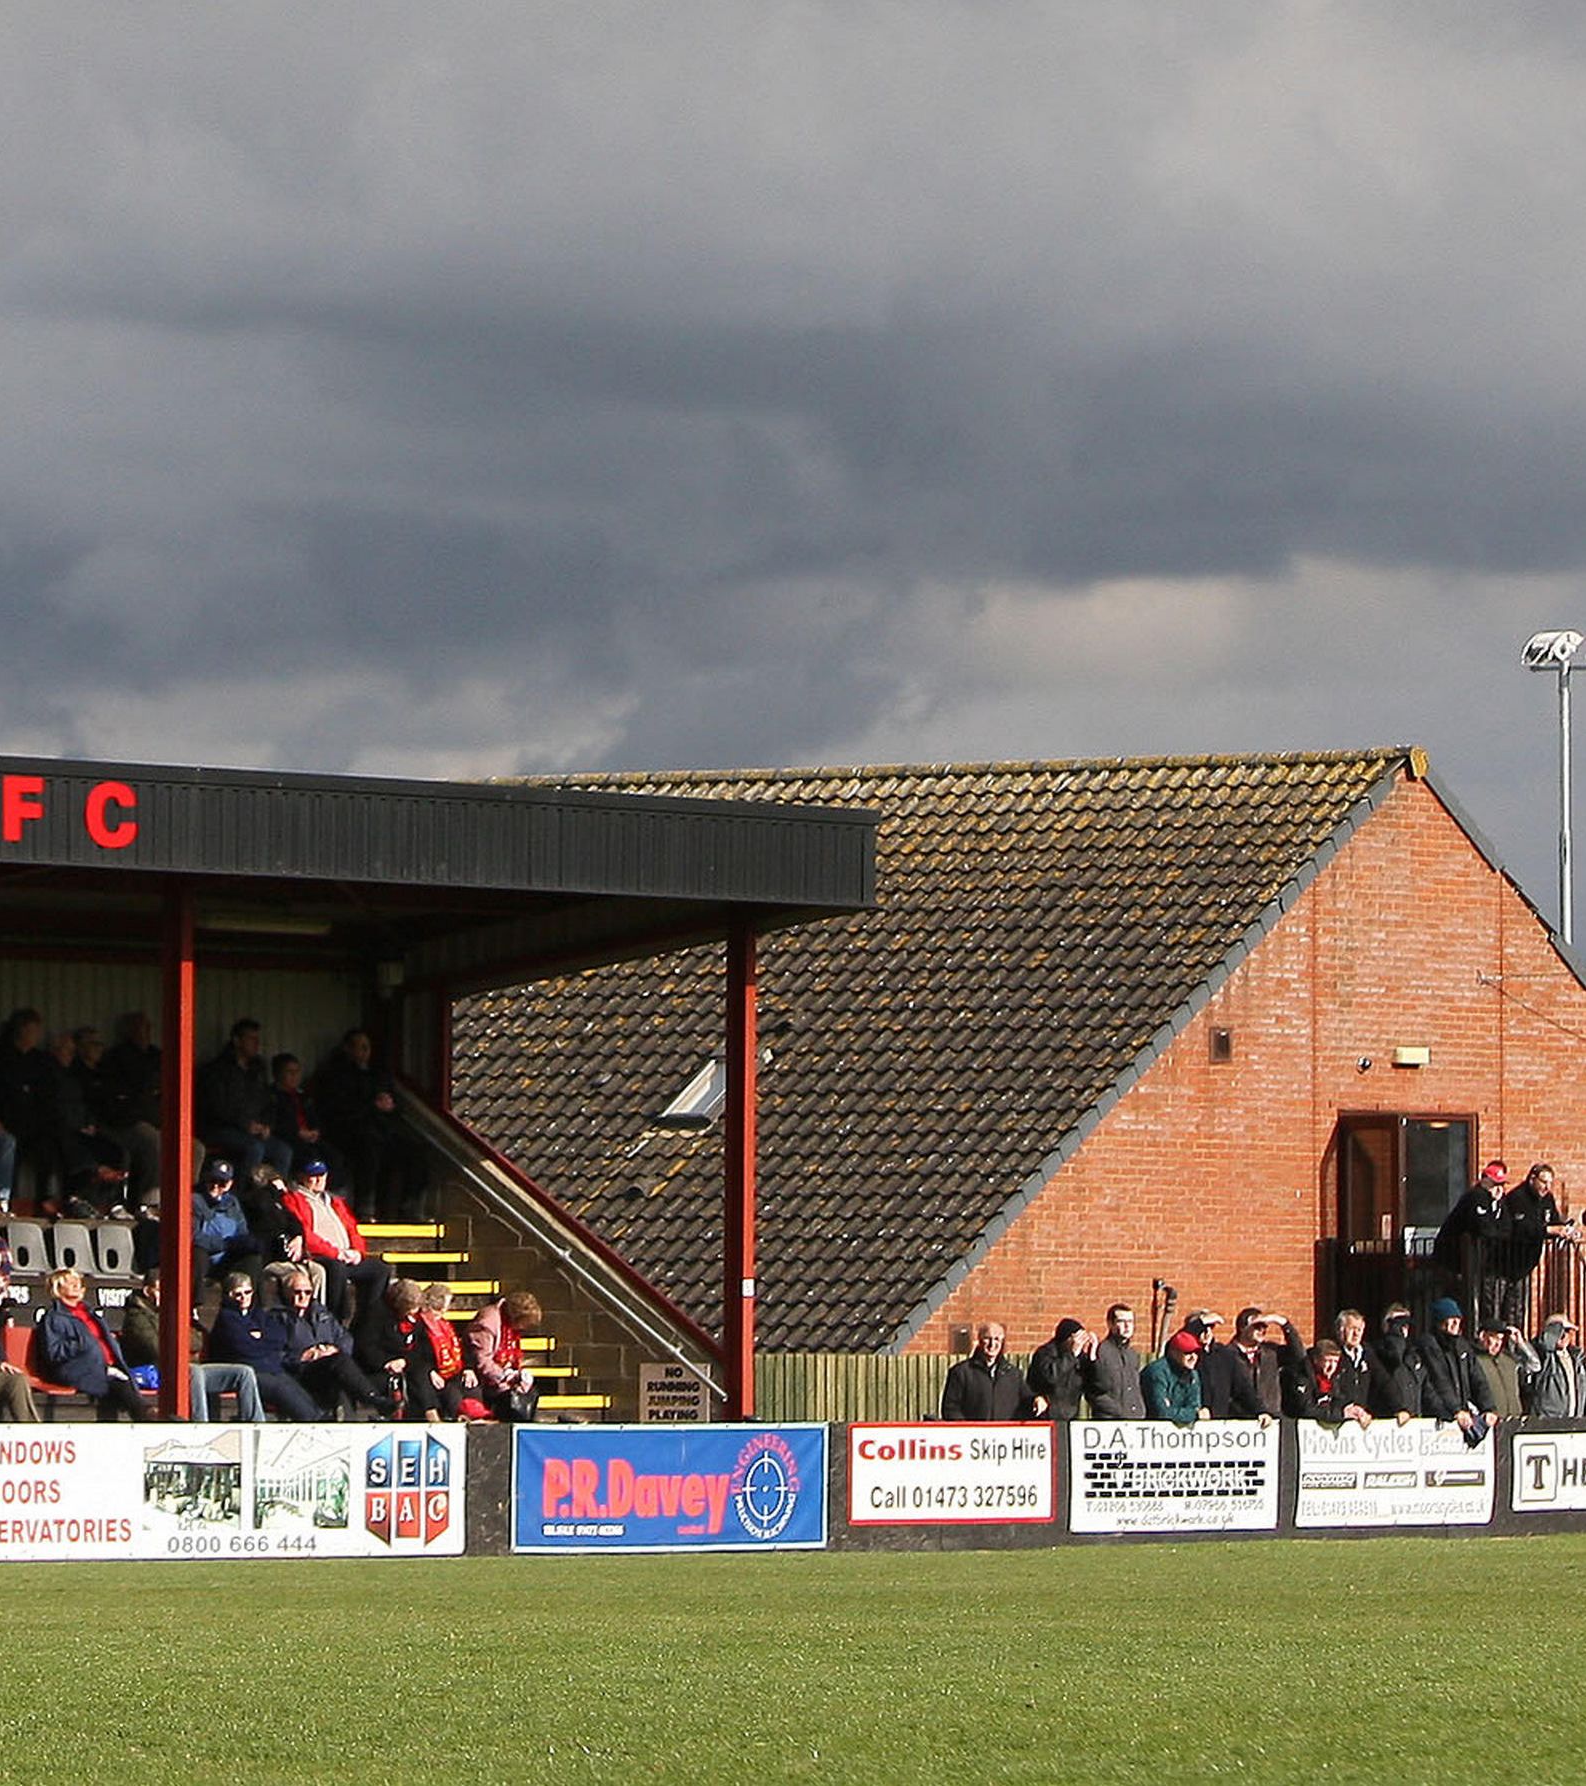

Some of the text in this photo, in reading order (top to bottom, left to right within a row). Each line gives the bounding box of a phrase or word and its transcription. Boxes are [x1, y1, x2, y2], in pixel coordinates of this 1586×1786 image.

[665, 1367, 683, 1378] NO
[647, 1381, 700, 1393] RUNNING
[647, 1395, 700, 1406] JUMPING
[648, 1409, 699, 1420] PLAYING
[858, 1437, 1047, 1465] Collins Skip Hire
[1364, 1429, 1413, 1460] Cycles
[370, 1457, 446, 1484] SEH
[730, 1433, 800, 1494] ENGINEERING
[1526, 1455, 1551, 1490] T
[370, 1494, 447, 1523] BAC
[870, 1485, 1039, 1509] Call 01473 327596
[167, 1535, 317, 1553] 0800 666 444
